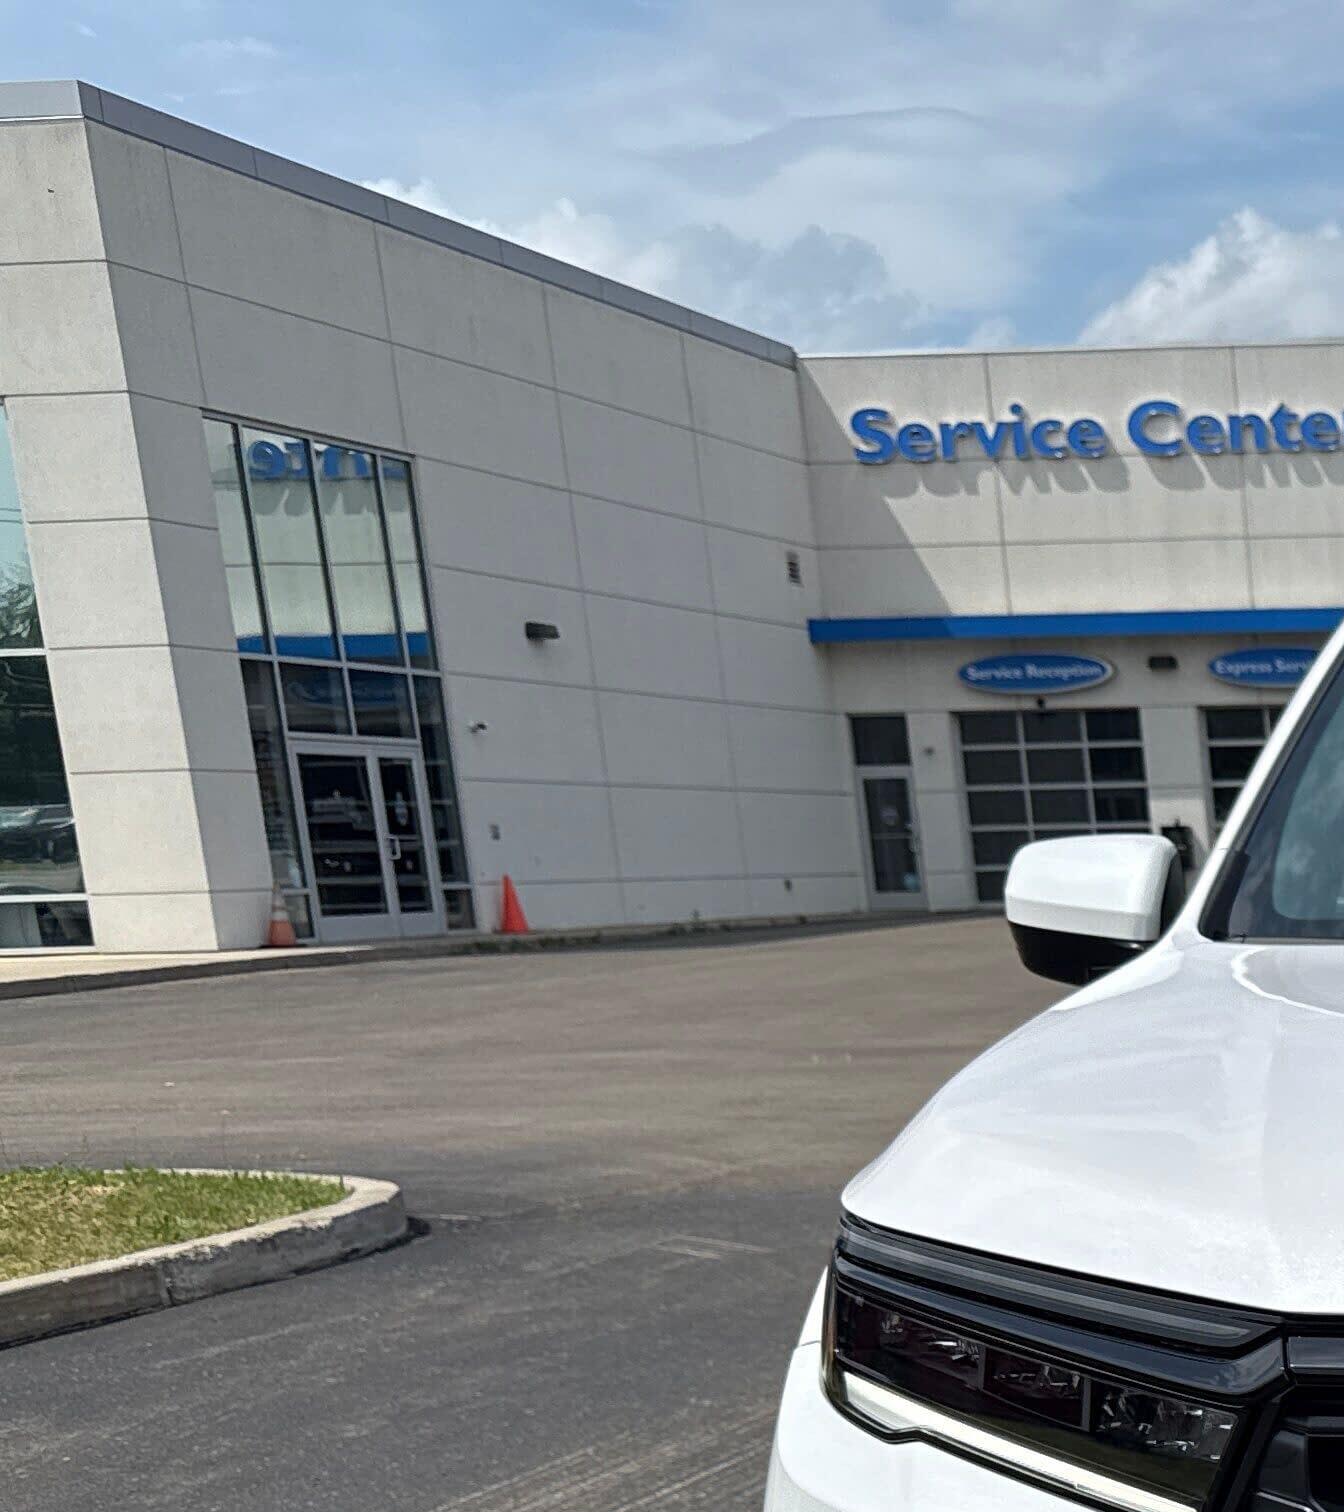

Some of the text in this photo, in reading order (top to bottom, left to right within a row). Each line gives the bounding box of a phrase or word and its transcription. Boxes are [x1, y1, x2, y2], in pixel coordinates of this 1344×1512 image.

[850, 403, 1104, 465] Service
[966, 662, 1103, 681] Service Reception
[1215, 660, 1274, 678] Express
